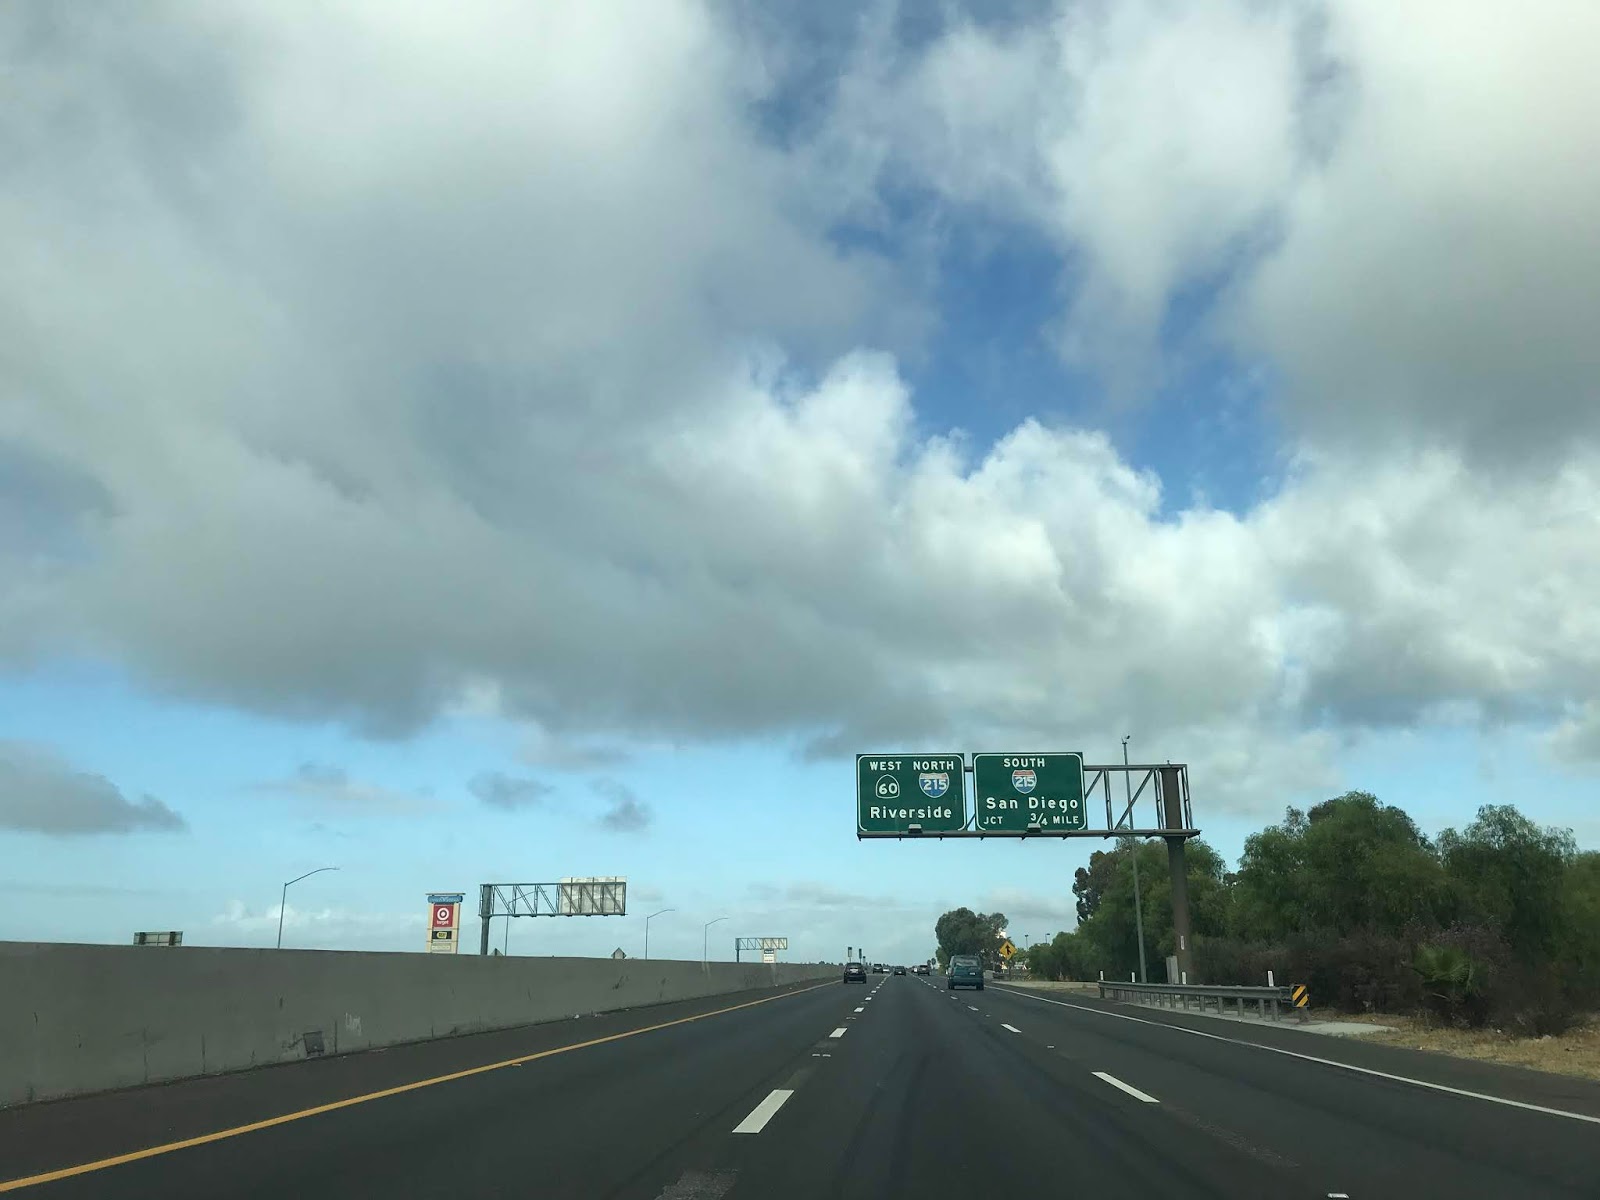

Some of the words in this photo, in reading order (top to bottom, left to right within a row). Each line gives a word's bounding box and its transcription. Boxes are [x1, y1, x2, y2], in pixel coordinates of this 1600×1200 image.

[869, 761, 902, 771] WEST
[913, 760, 954, 771] NORTH
[1003, 758, 1045, 768] SOUTH
[923, 779, 947, 791] 215
[1014, 776, 1035, 787] 215
[878, 782, 898, 795] 60
[986, 797, 1018, 809] San
[1028, 796, 1078, 813] Diego
[870, 805, 952, 819] Riverside
[983, 816, 1003, 825] JCT
[1052, 815, 1079, 824] MILE
